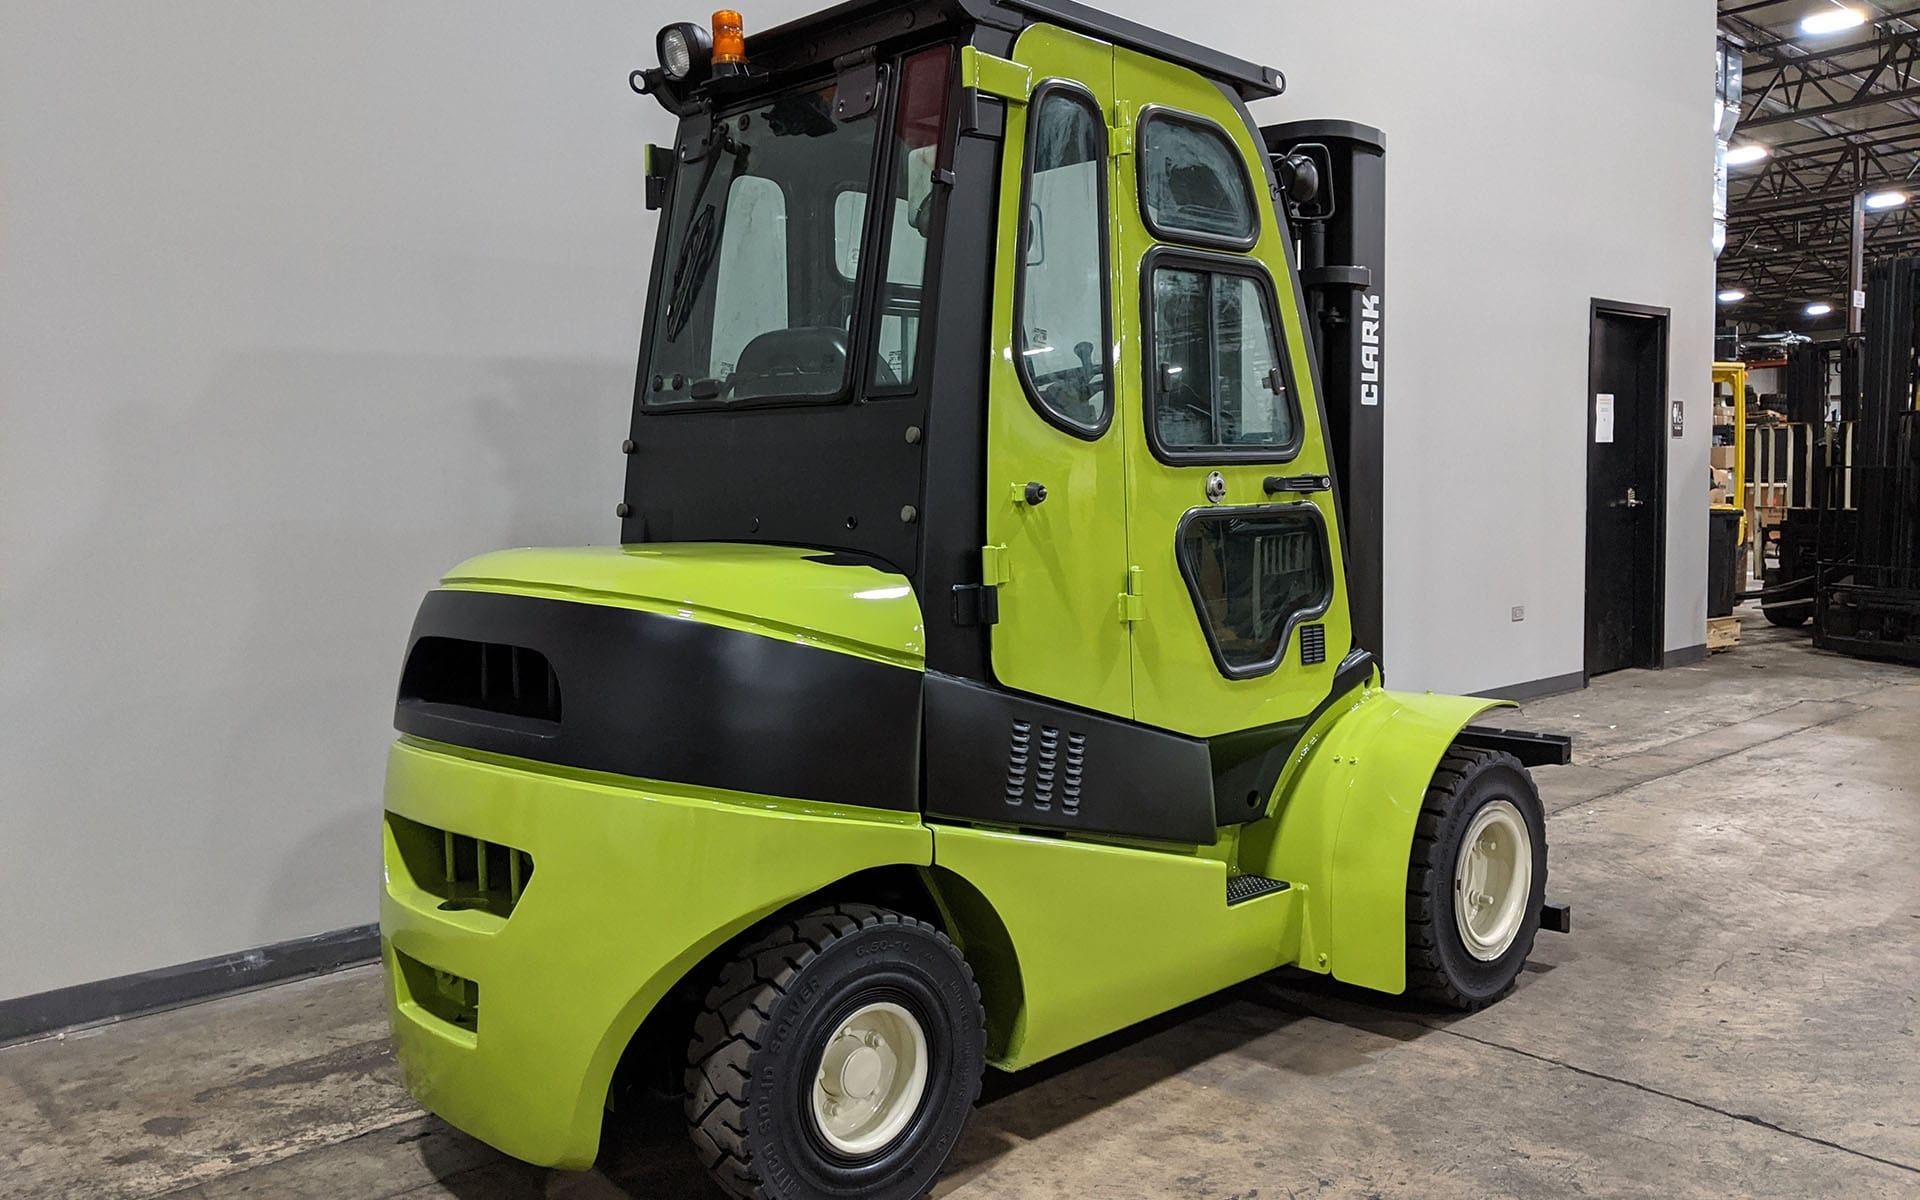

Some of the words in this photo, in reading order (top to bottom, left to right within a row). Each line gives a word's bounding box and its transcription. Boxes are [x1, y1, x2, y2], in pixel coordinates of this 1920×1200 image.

[1361, 295, 1380, 406] CLARK
[759, 1066, 774, 1134] SOLID
[769, 978, 819, 1053] SOLVER
